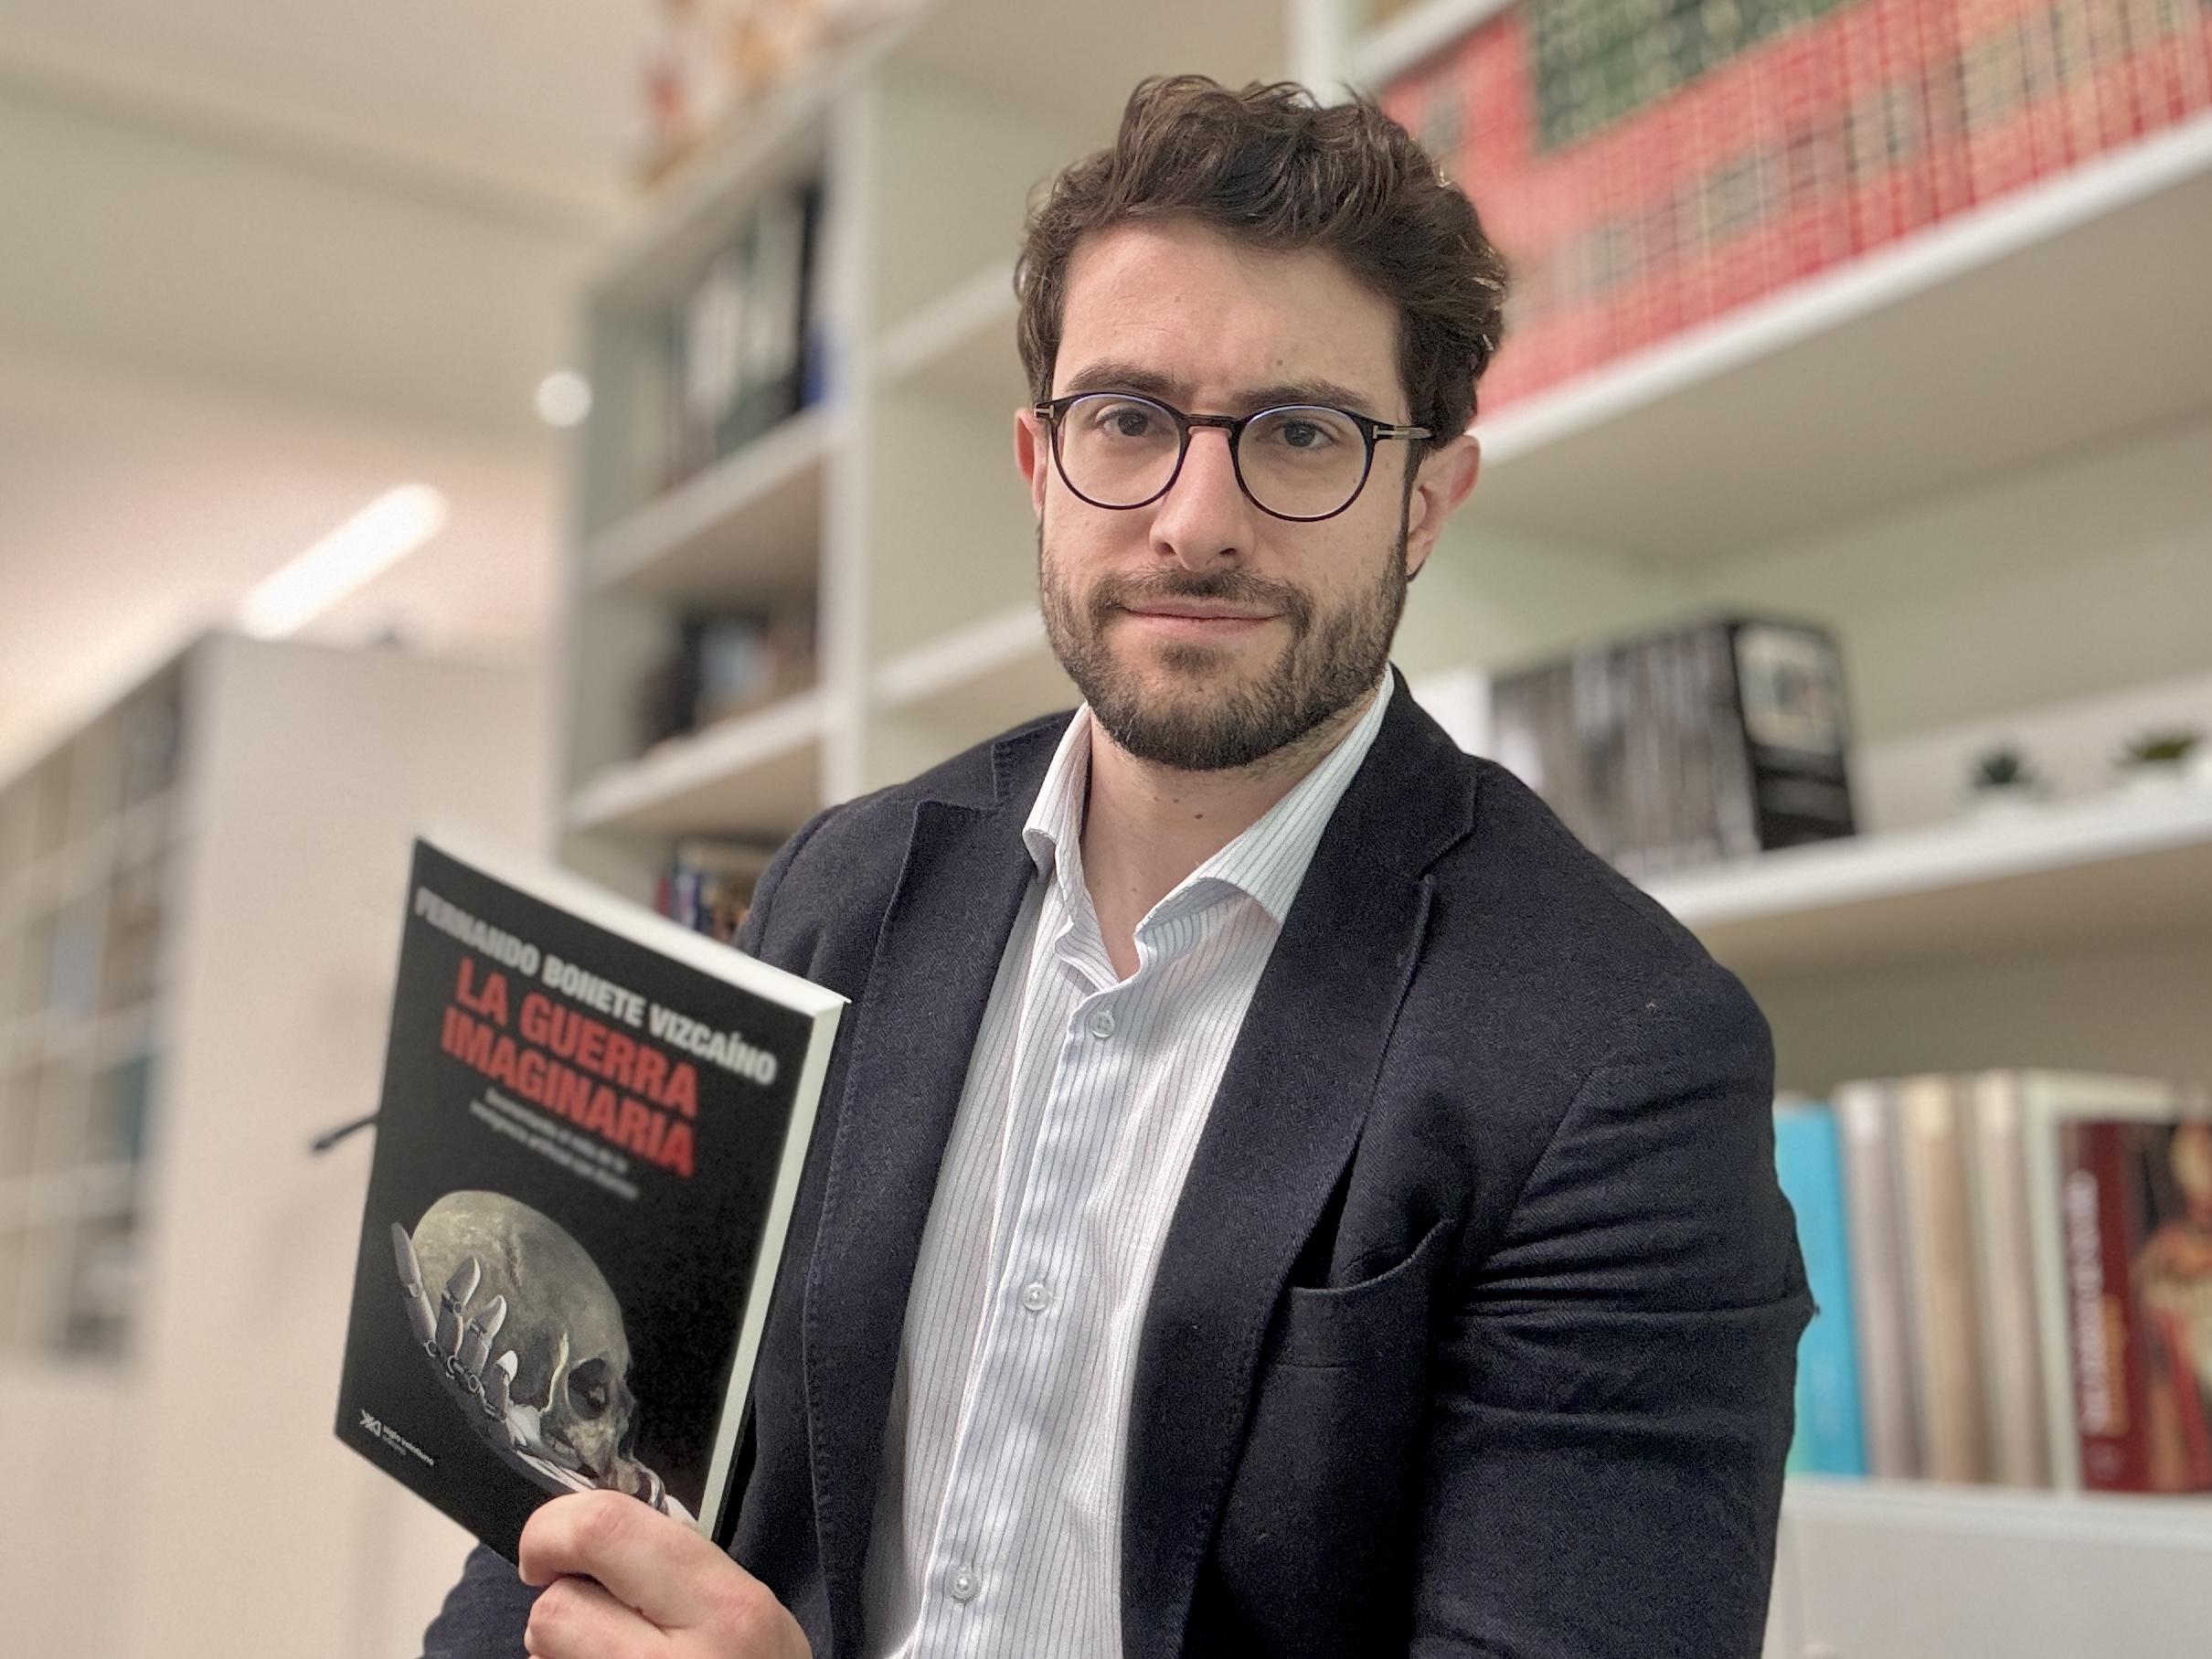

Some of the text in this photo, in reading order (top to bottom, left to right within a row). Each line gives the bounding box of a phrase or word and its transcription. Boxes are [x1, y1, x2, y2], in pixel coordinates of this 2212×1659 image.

[441, 1006, 697, 1179] IMAGINARIA
[455, 957, 698, 1120] LA GUERRA
[542, 953, 646, 1027] BONETE
[649, 1003, 778, 1085] VIZCAÍNO
